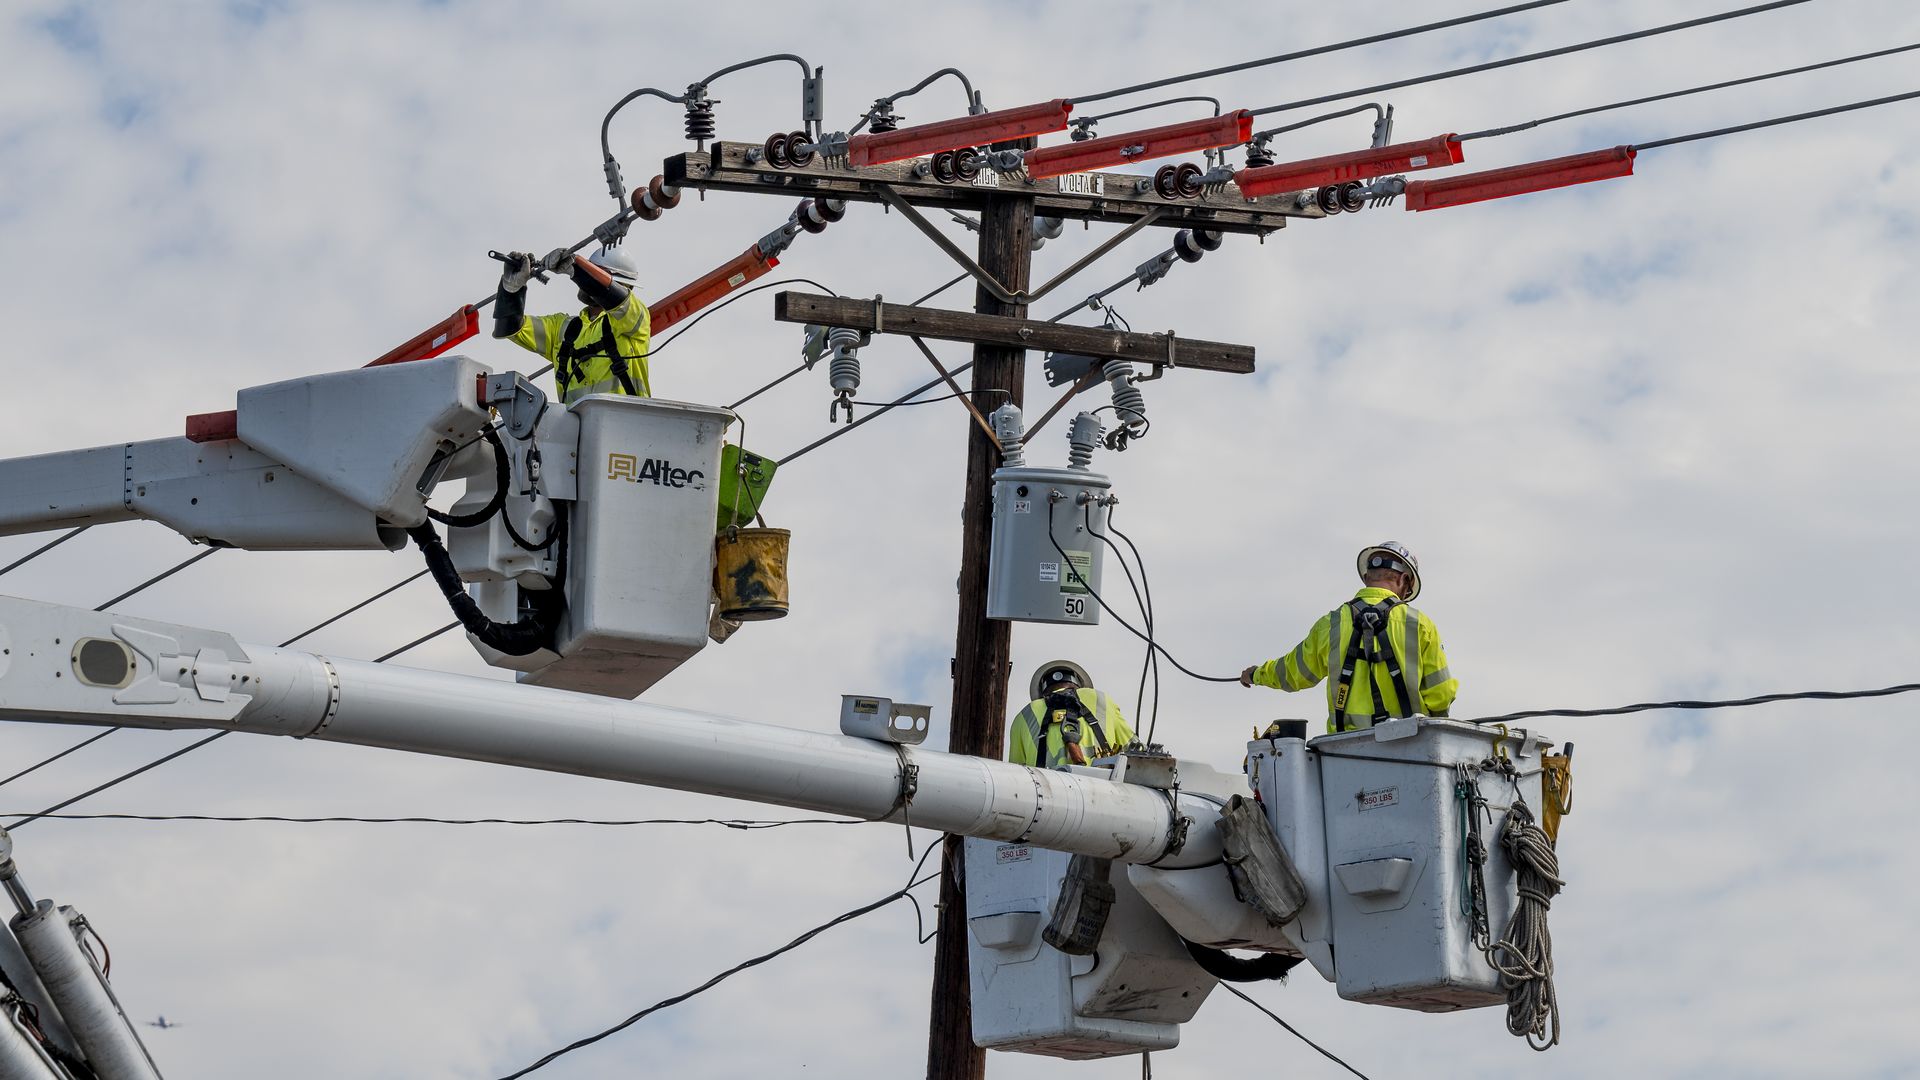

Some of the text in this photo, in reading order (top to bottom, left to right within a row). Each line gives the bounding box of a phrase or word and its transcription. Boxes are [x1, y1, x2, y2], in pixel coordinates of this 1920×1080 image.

[637, 458, 705, 490] Altec
[1065, 598, 1084, 614] 50
[1364, 793, 1393, 804] 350 LBS
[1016, 848, 1028, 856] LBS
